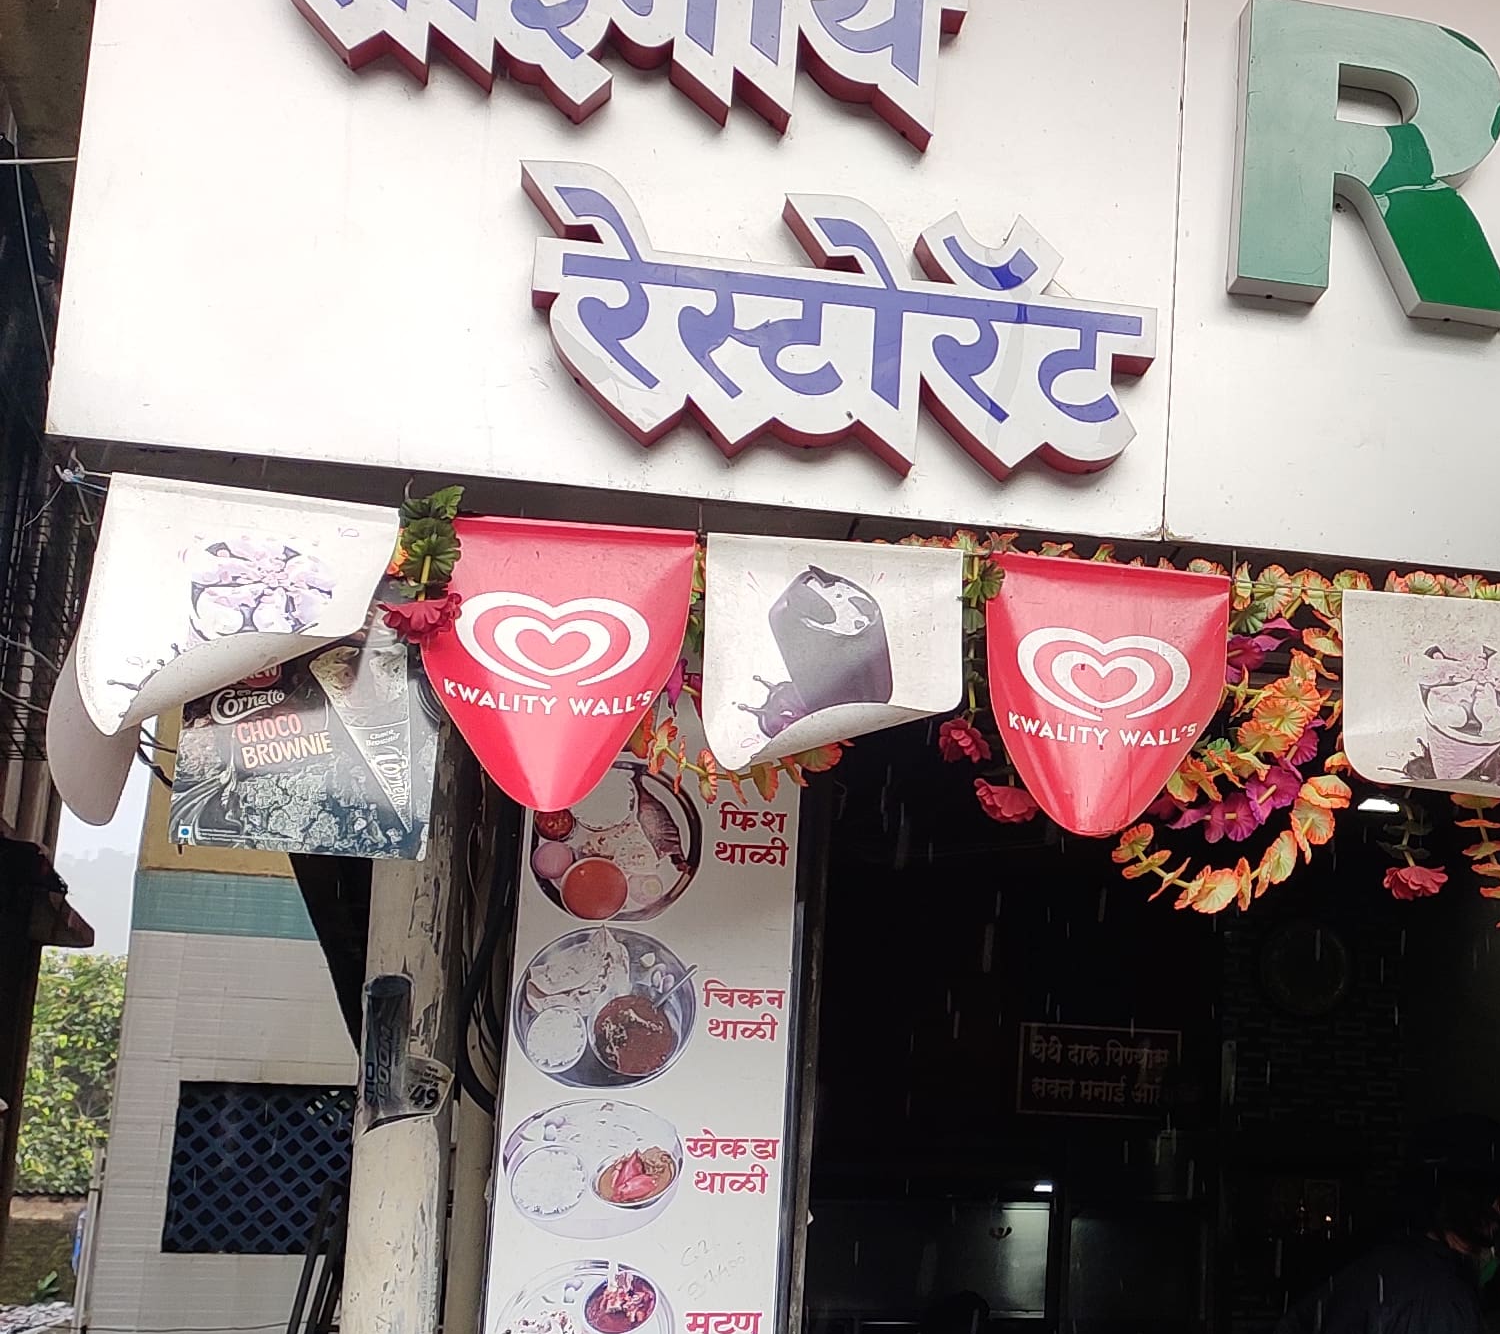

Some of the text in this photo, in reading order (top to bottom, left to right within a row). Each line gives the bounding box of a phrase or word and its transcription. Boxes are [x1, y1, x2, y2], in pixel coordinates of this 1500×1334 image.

[211, 689, 284, 724] Cornetto
[444, 677, 653, 717] KWALITY WALL'S
[237, 713, 302, 744] CHOCO
[1008, 710, 1198, 748] KWALITY WALL'S
[718, 803, 788, 834] फिश
[714, 837, 790, 867] थाळी
[702, 980, 786, 1011] चिकन
[707, 1014, 778, 1042] थाळी
[686, 1128, 779, 1160] खेकडा
[694, 1164, 768, 1194] थाळी
